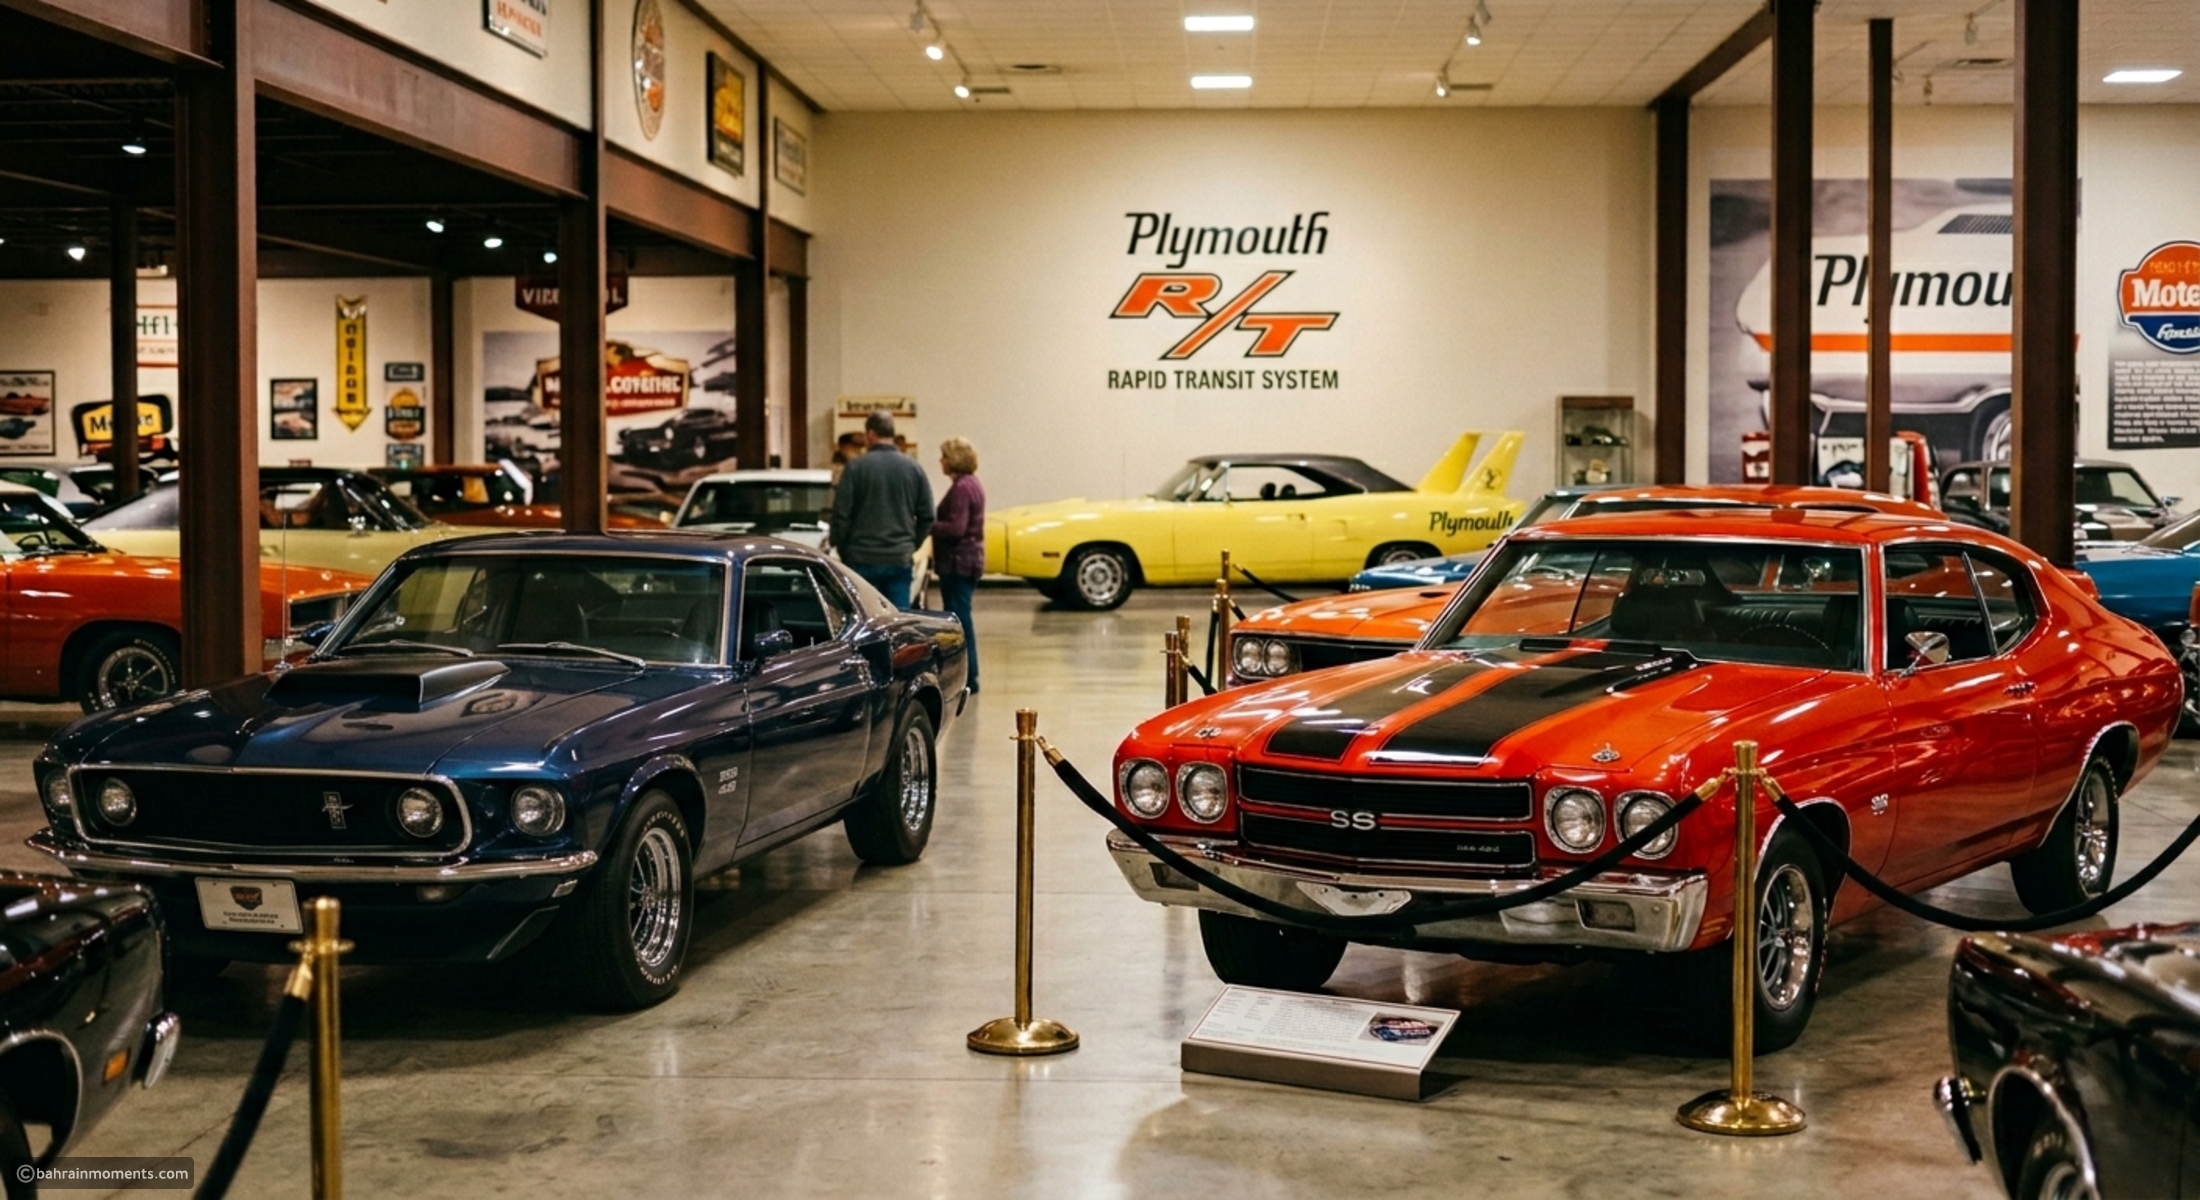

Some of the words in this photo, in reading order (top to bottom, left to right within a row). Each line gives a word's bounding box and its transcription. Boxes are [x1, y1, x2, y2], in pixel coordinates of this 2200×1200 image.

[1125, 211, 1330, 269] Plymouth
[1108, 270, 1341, 361] R/T
[1107, 370, 1167, 389] RAPID
[1174, 370, 1256, 389] TRANSIT
[1261, 370, 1339, 389] SYSTEM
[1330, 810, 1376, 830] SS
